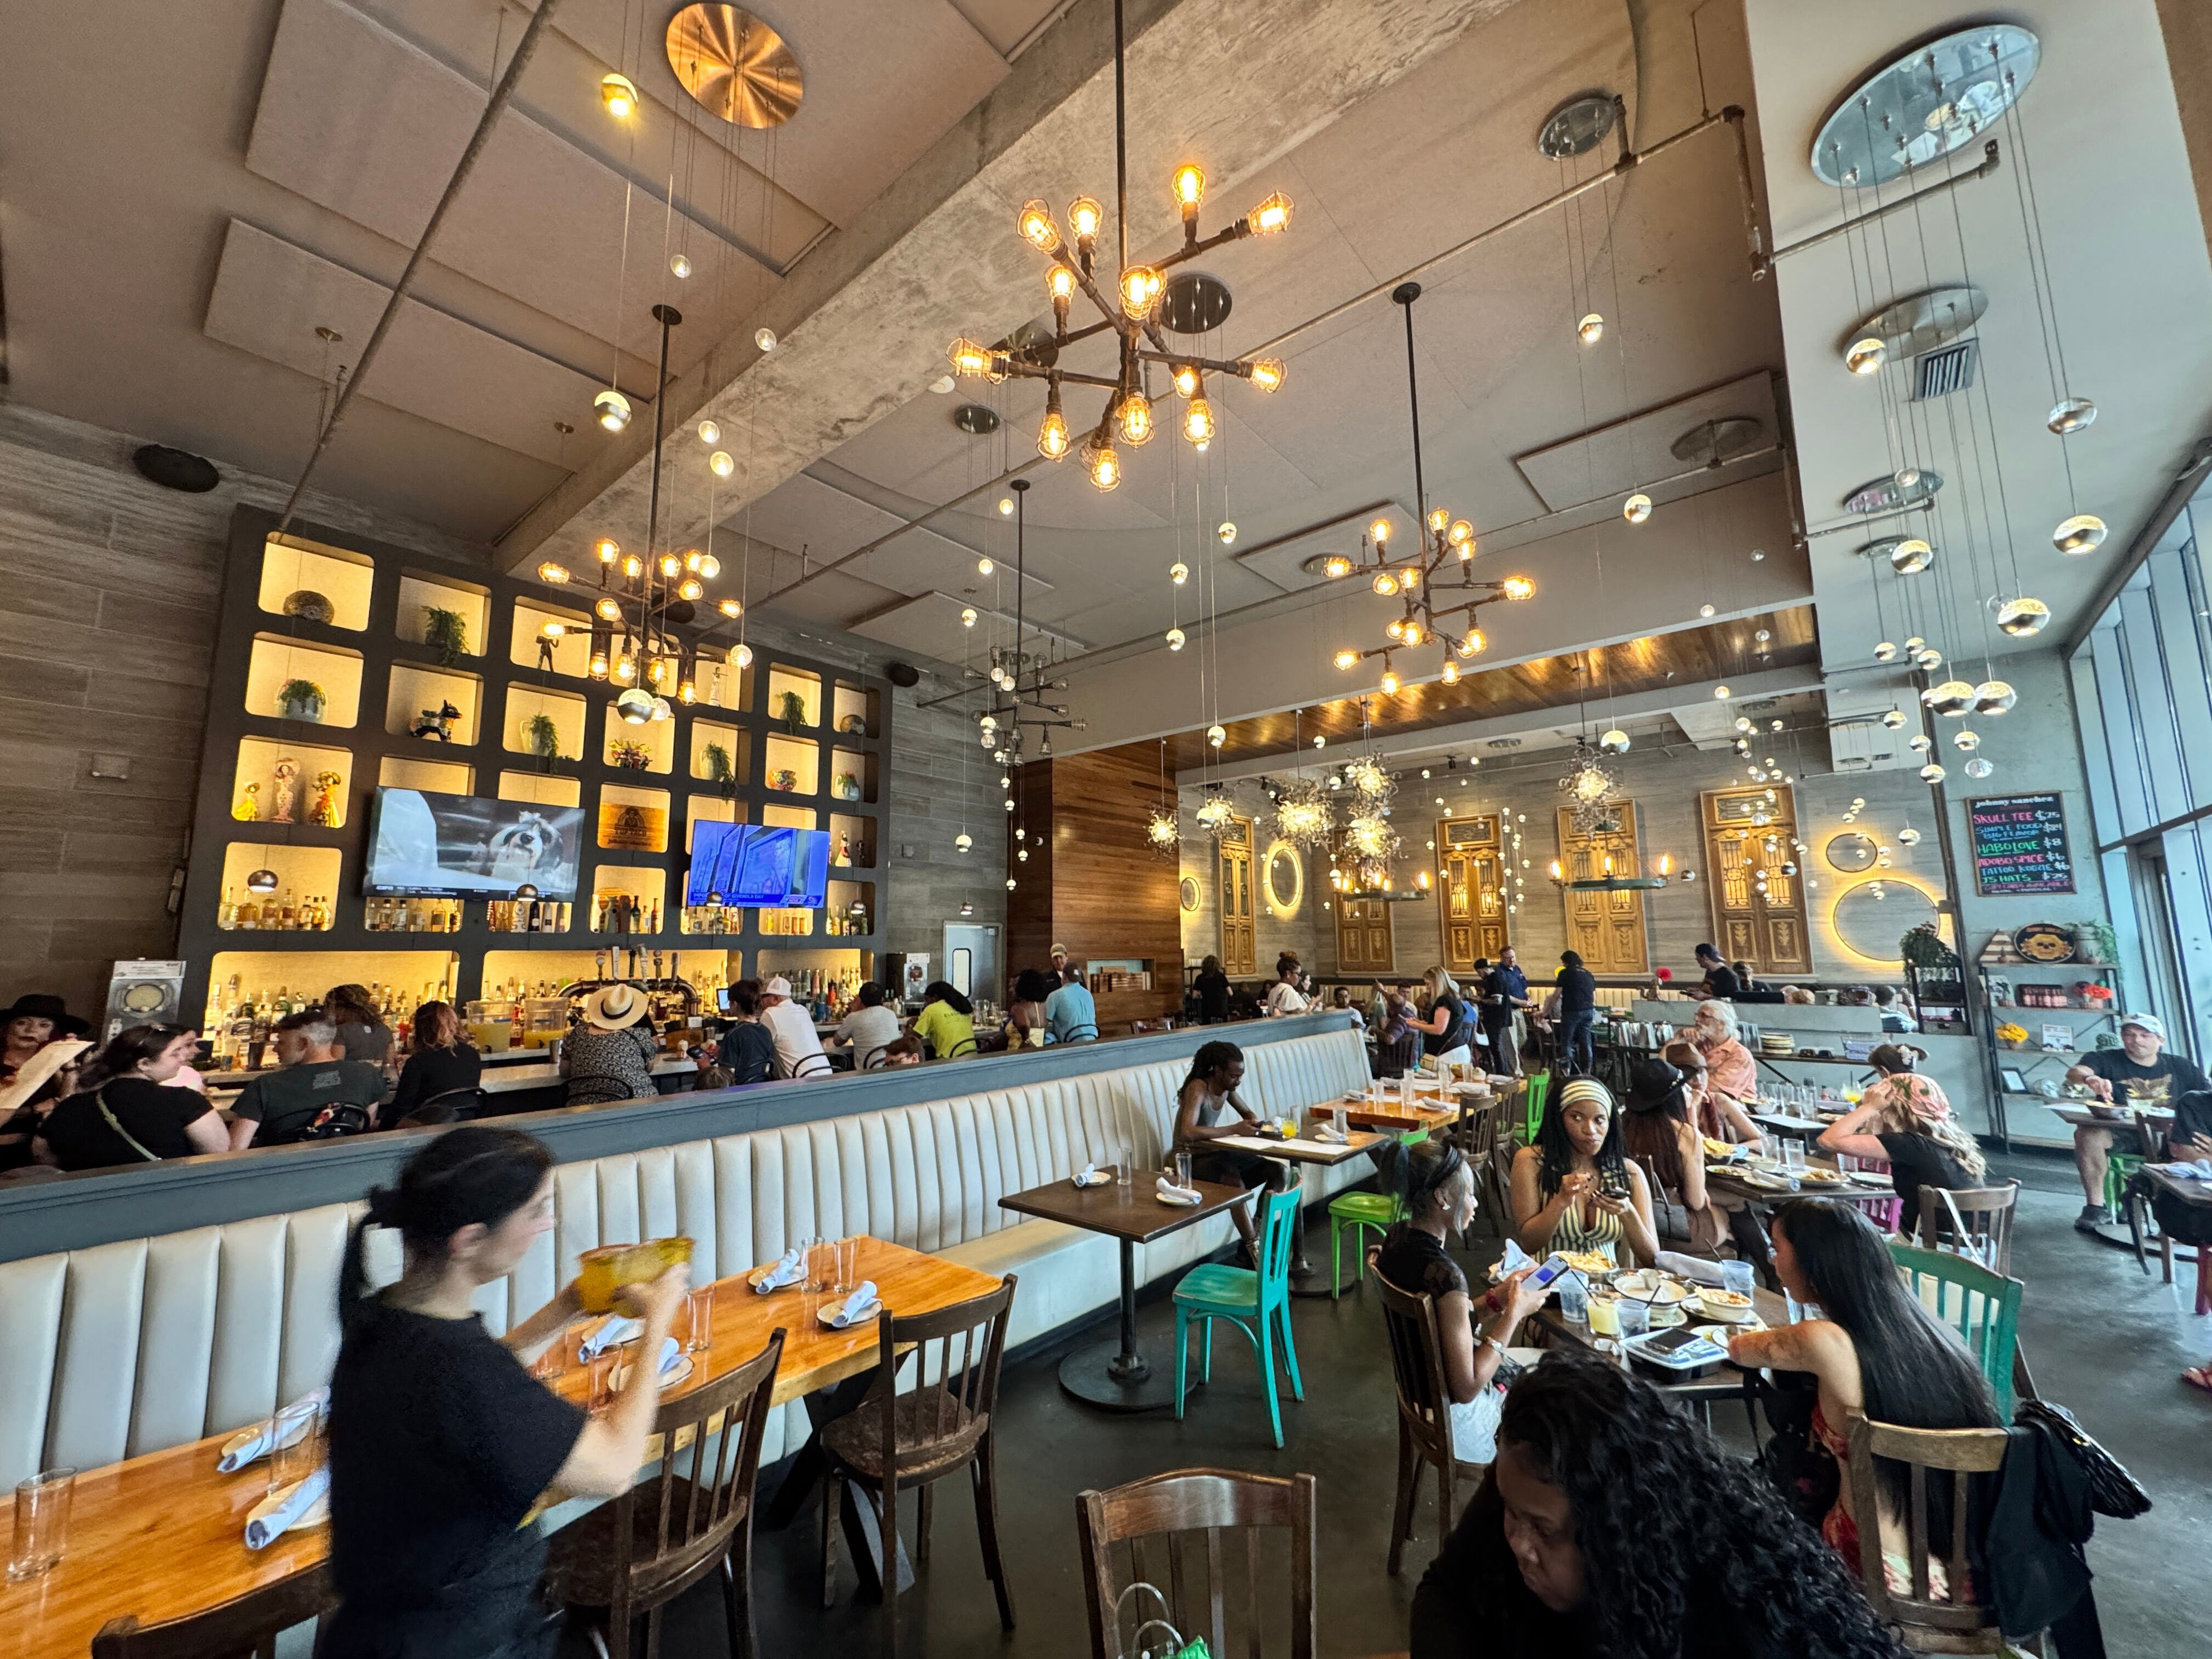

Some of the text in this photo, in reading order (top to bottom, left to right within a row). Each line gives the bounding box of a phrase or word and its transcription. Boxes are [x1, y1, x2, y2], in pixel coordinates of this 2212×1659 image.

[1973, 810, 2060, 823] SKULL TEE $25
[2044, 837, 2062, 848] $8
[2013, 853, 2045, 864] SPICE
[1999, 874, 2031, 882] HATS
